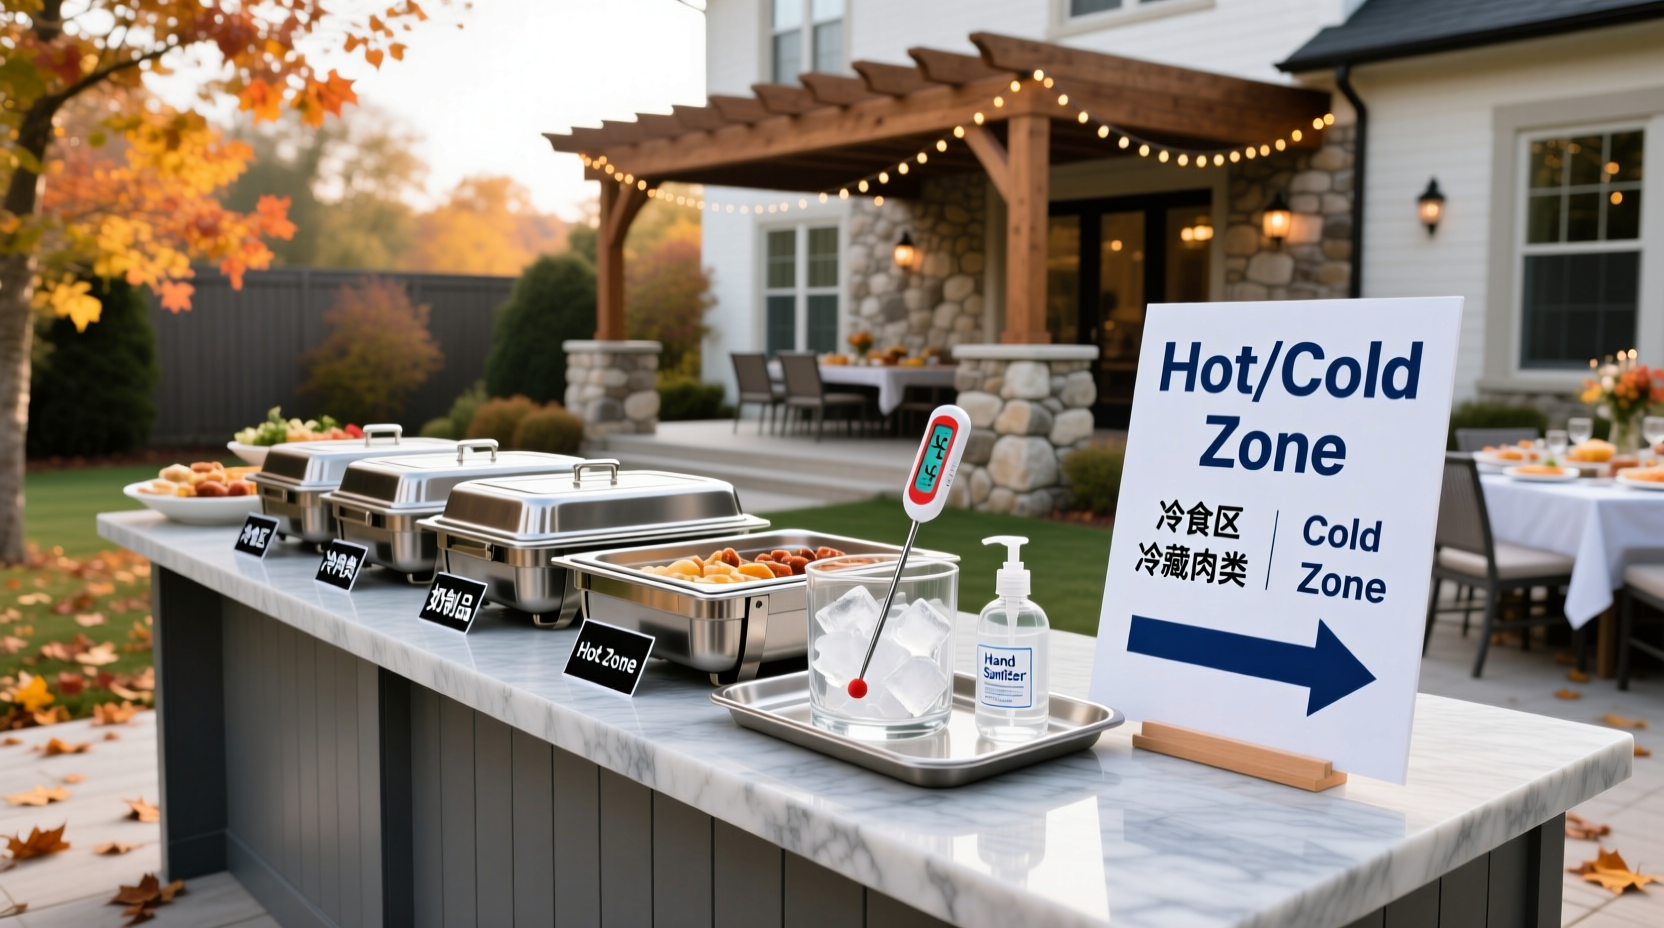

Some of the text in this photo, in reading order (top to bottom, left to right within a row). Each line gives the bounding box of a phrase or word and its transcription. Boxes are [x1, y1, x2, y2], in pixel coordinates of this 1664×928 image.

[1160, 341, 1423, 402] Hot/Cold
[1199, 415, 1346, 476] Zone
[1156, 499, 1244, 540] 冷食区
[1303, 515, 1382, 553] Cold
[1135, 542, 1248, 588] 冷藏肉类
[1297, 562, 1387, 604] Zone
[576, 641, 637, 674] Hot Zone
[984, 652, 1016, 668] Hand
